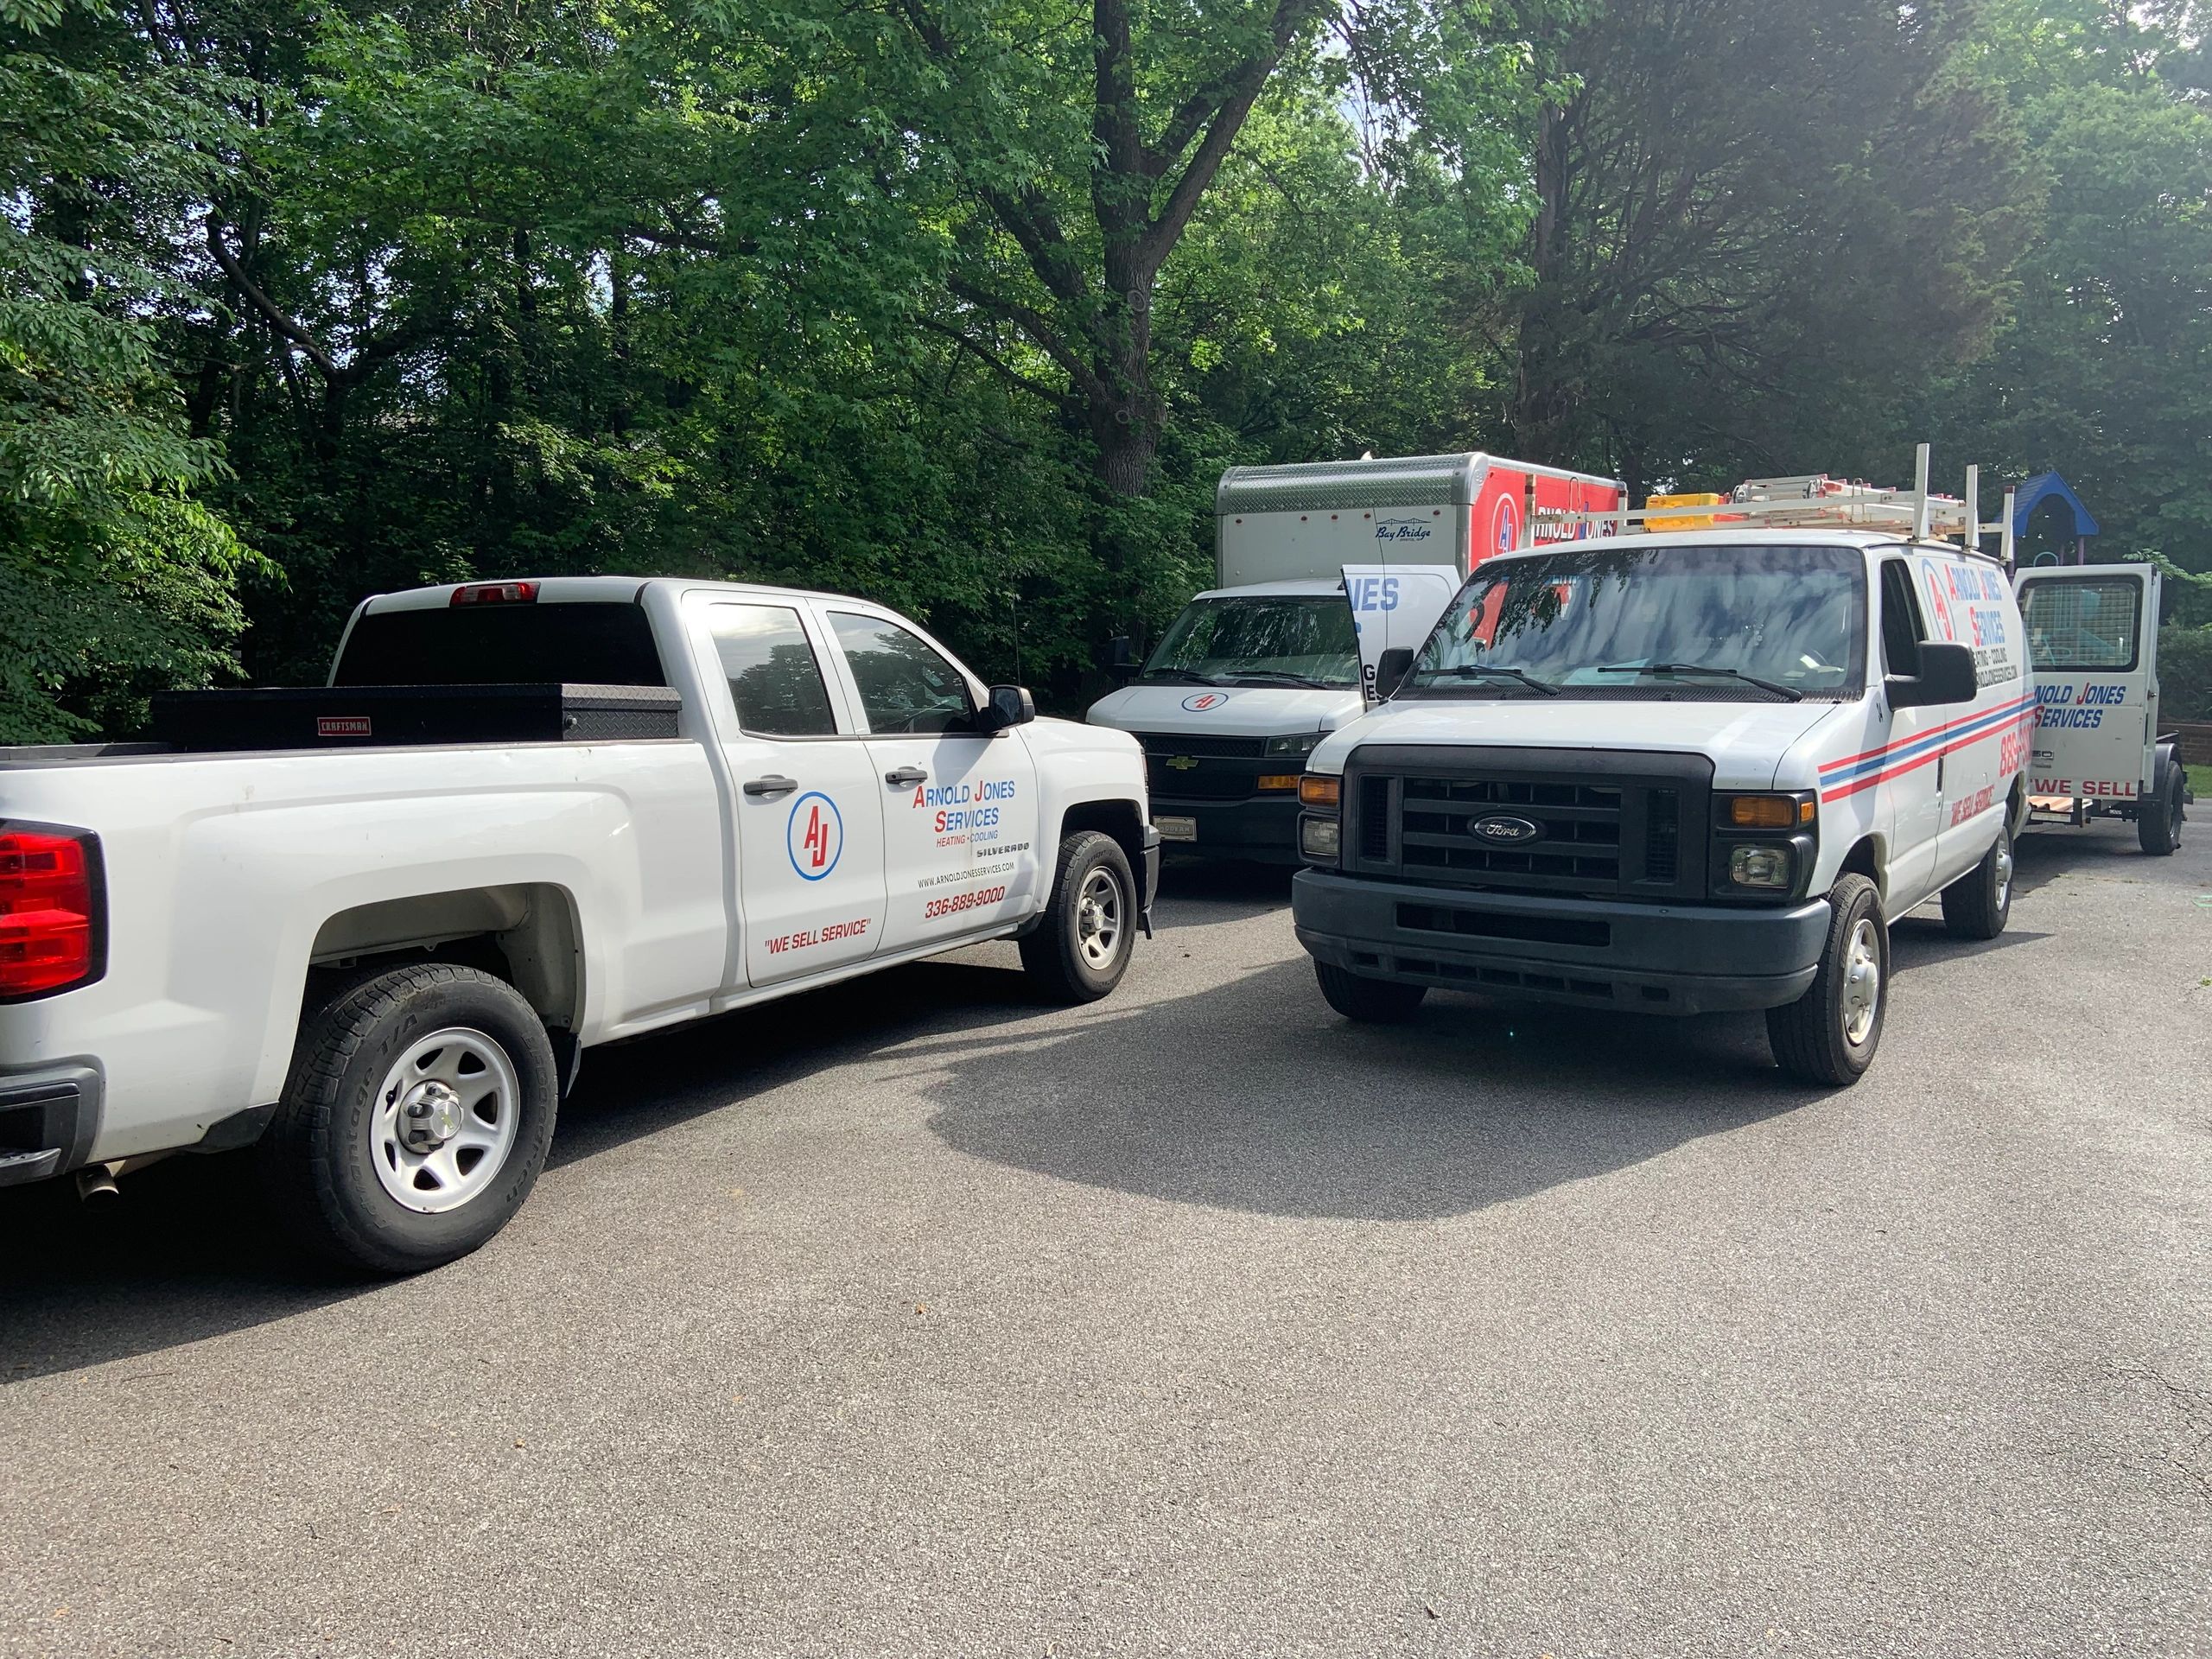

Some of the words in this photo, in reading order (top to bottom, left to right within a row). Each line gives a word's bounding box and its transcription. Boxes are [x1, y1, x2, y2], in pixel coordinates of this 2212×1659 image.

[1376, 526, 1395, 541] Bay
[1396, 526, 1431, 540] Bridge
[1929, 574, 1953, 640] AJ
[1970, 607, 2005, 647] SERVICES
[2076, 682, 2126, 705] JONES
[321, 721, 367, 732] CRAFTSMAN
[2035, 705, 2103, 728] SERVICES
[912, 785, 969, 809] ARNOLD
[975, 780, 1015, 802] JONES
[2082, 781, 2136, 796] SELL
[934, 807, 999, 833] SERVICES
[804, 805, 828, 868] AJ
[937, 835, 965, 848] HEATING
[969, 830, 998, 843] COOLING
[976, 842, 1030, 857] SILVERADO
[918, 861, 1015, 889] WWW.ARNOLDJONESSERVICES.COM
[925, 886, 1006, 918] 336-889-9000
[791, 930, 818, 950] SELL
